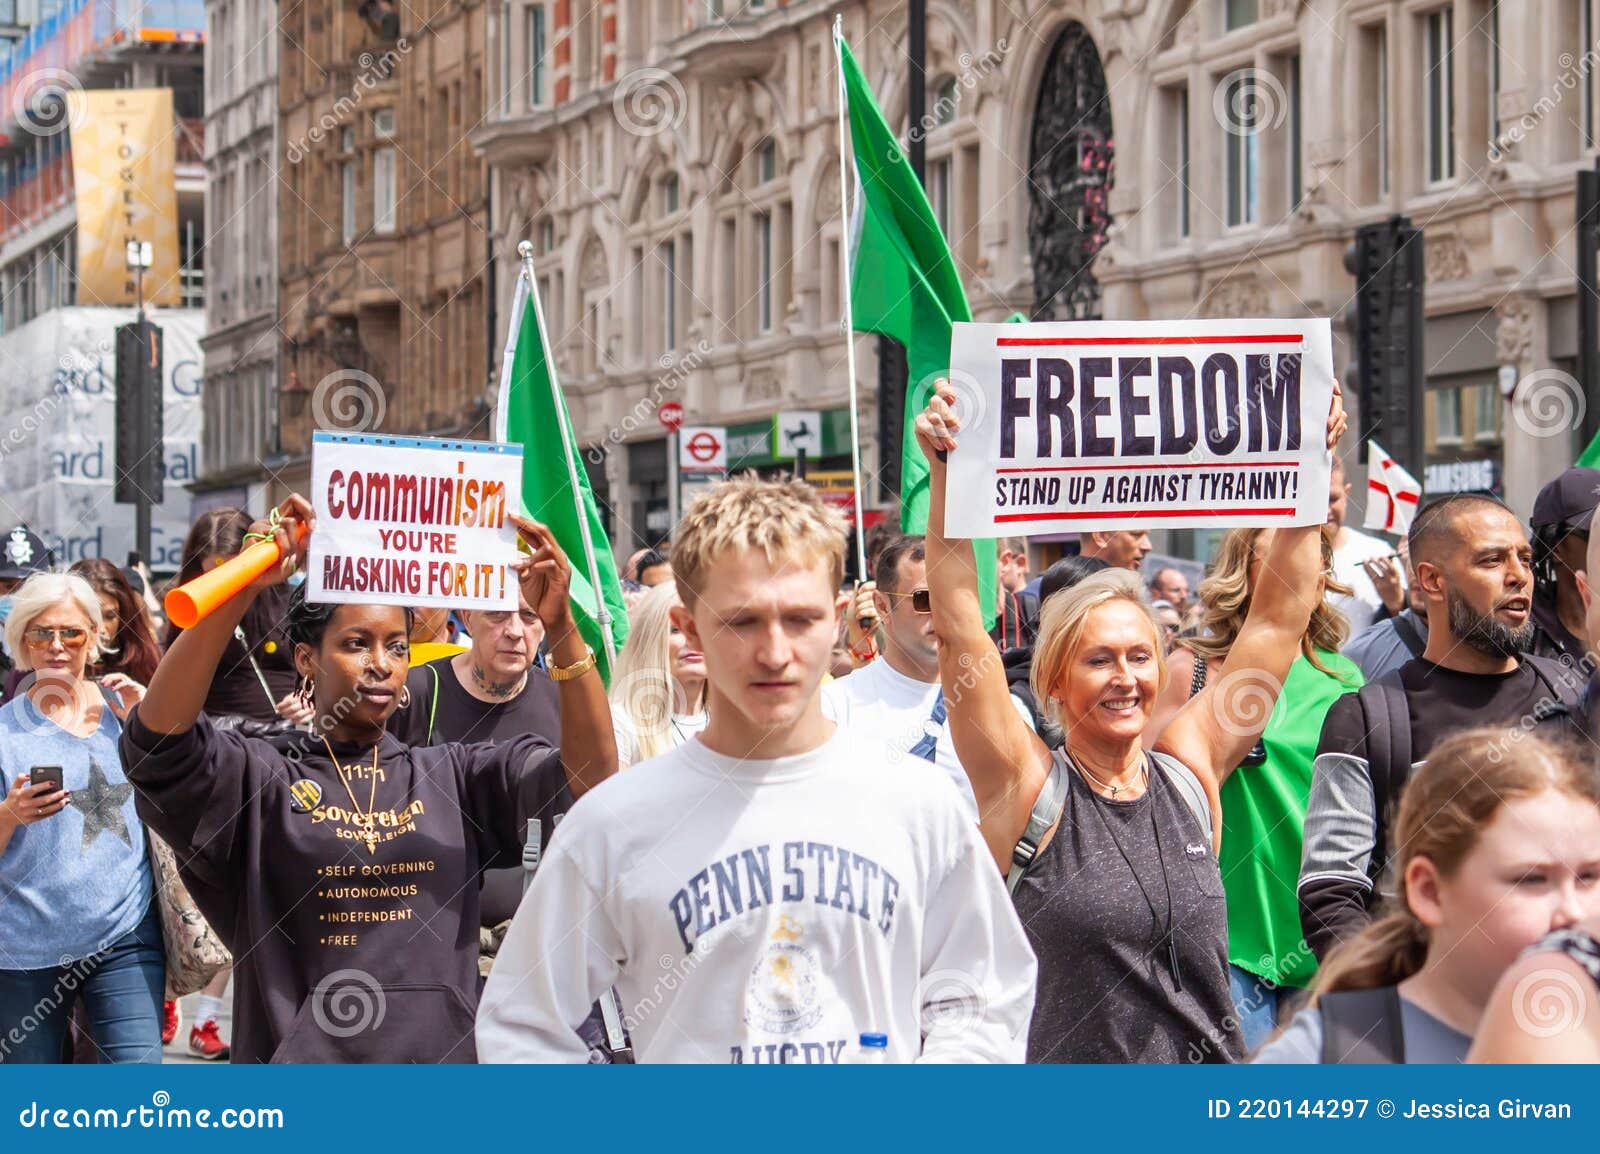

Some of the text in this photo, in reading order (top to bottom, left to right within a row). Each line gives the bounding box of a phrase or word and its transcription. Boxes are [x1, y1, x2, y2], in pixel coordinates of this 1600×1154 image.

[117, 122, 136, 295] TOGETR
[999, 352, 1303, 458] FREEDOM
[327, 461, 506, 529] communism
[996, 470, 1298, 506] STAND UP AGAINST TYRANNY!
[379, 529, 457, 554] YOU'RE
[322, 555, 421, 594] MASKING
[427, 560, 468, 597] FOR
[325, 860, 436, 876] SELF GOVERNING
[326, 884, 418, 898] AUTONOMOUS
[668, 841, 900, 955] PENN STATE
[327, 908, 413, 923] INDEPENDENT
[327, 935, 358, 946] FREE
